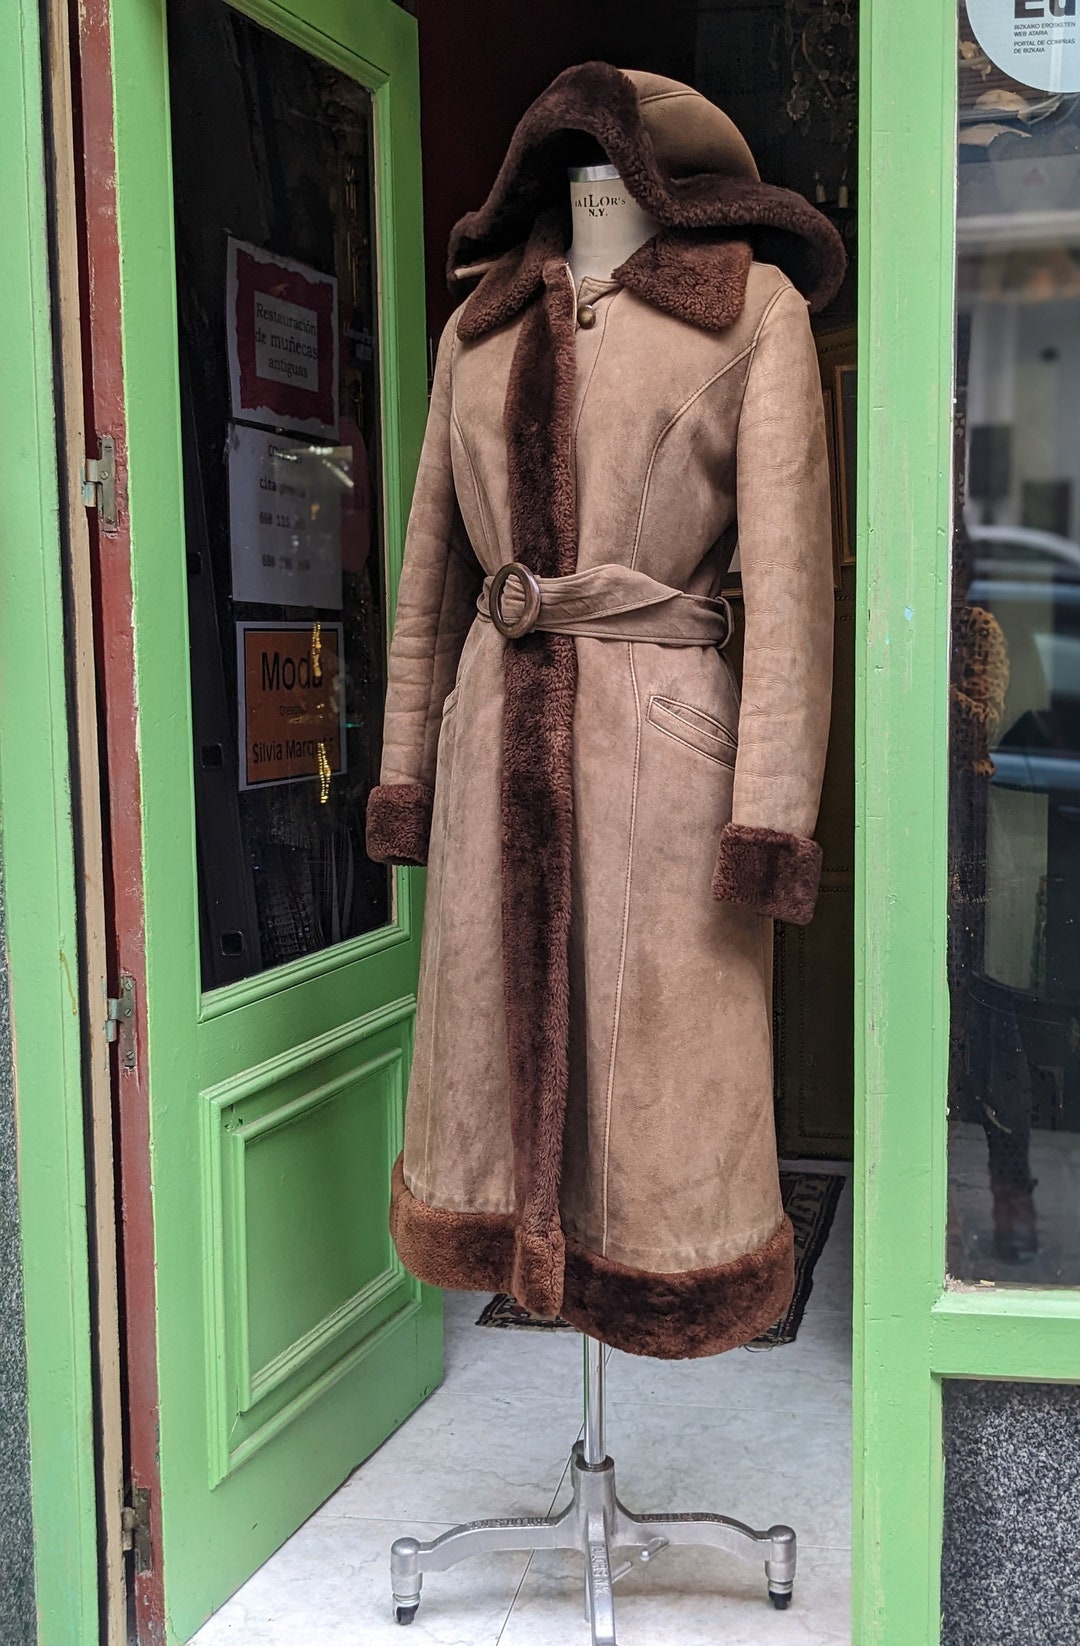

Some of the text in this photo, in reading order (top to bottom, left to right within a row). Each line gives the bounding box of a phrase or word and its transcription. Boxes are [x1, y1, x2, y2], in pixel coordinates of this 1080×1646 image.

[588, 208, 608, 218] N.Y.
[256, 302, 317, 336] Restauración
[256, 328, 318, 360] de muñecas
[268, 356, 309, 378] antiguas
[252, 740, 283, 764] Silvia
